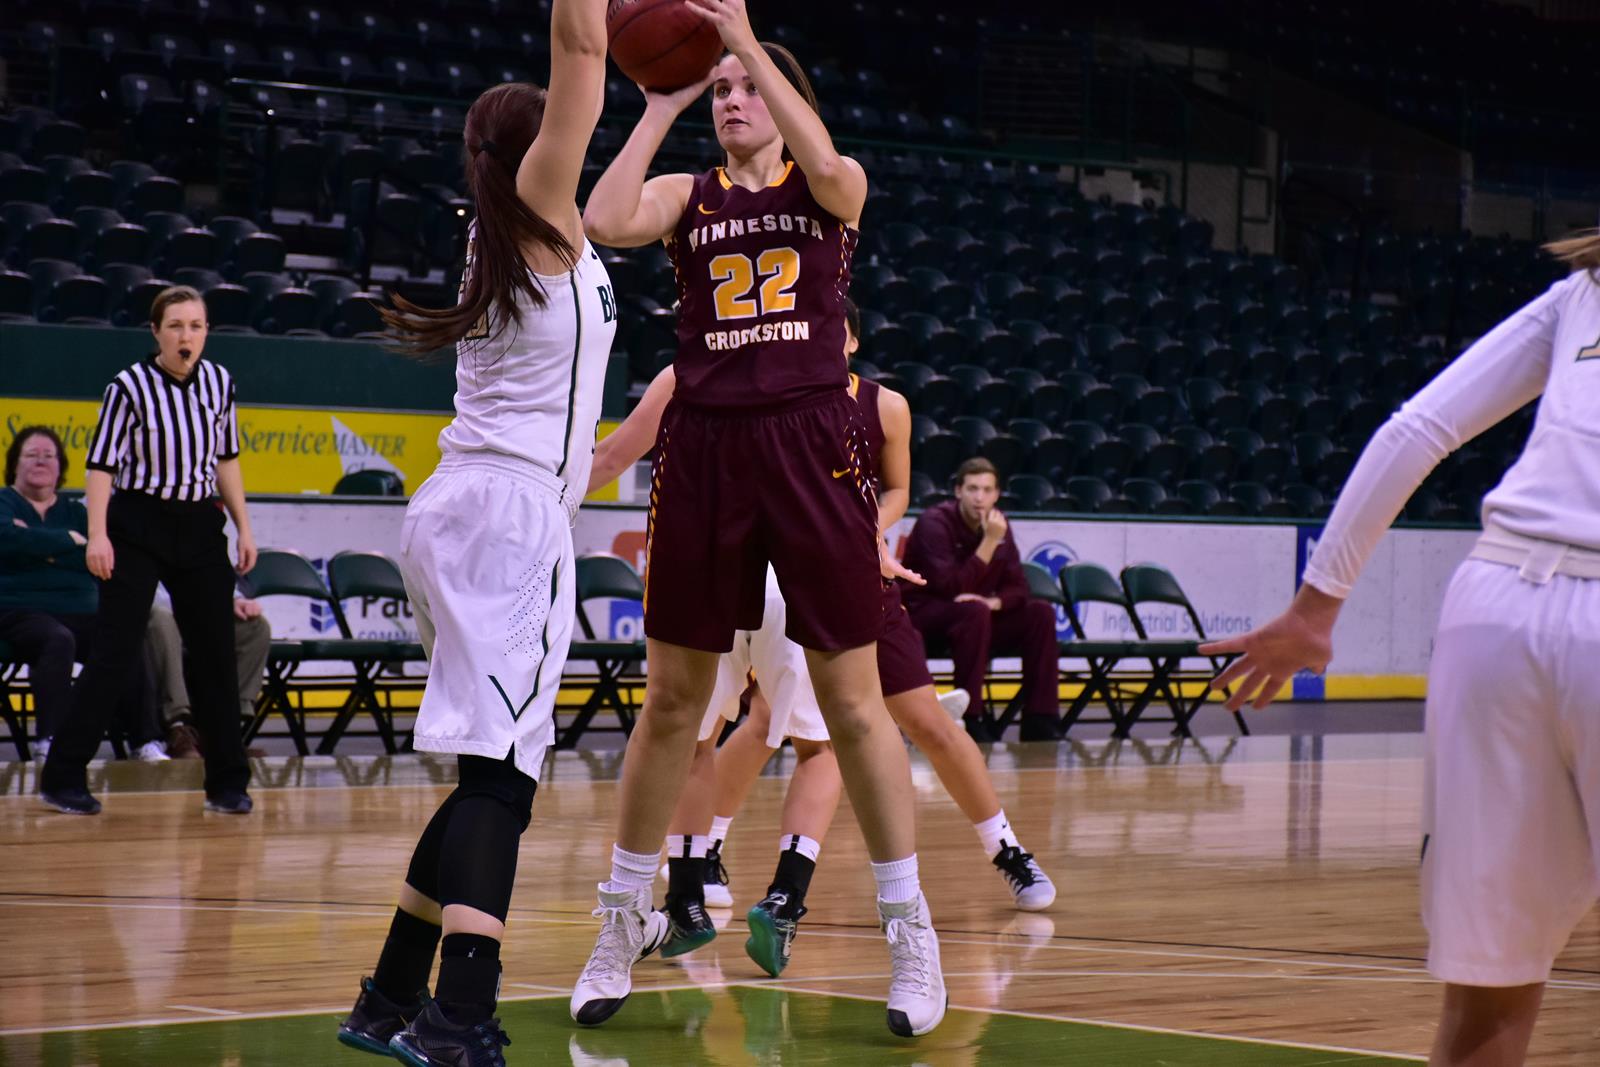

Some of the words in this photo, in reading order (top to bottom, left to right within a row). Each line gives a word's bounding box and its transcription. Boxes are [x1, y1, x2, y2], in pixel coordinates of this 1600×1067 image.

[688, 214, 823, 253] MINNESOTA
[709, 246, 800, 320] 22
[704, 321, 809, 351] CROOKSTON
[1103, 610, 1177, 633] Indstrial
[1182, 611, 1253, 633] Slutions
